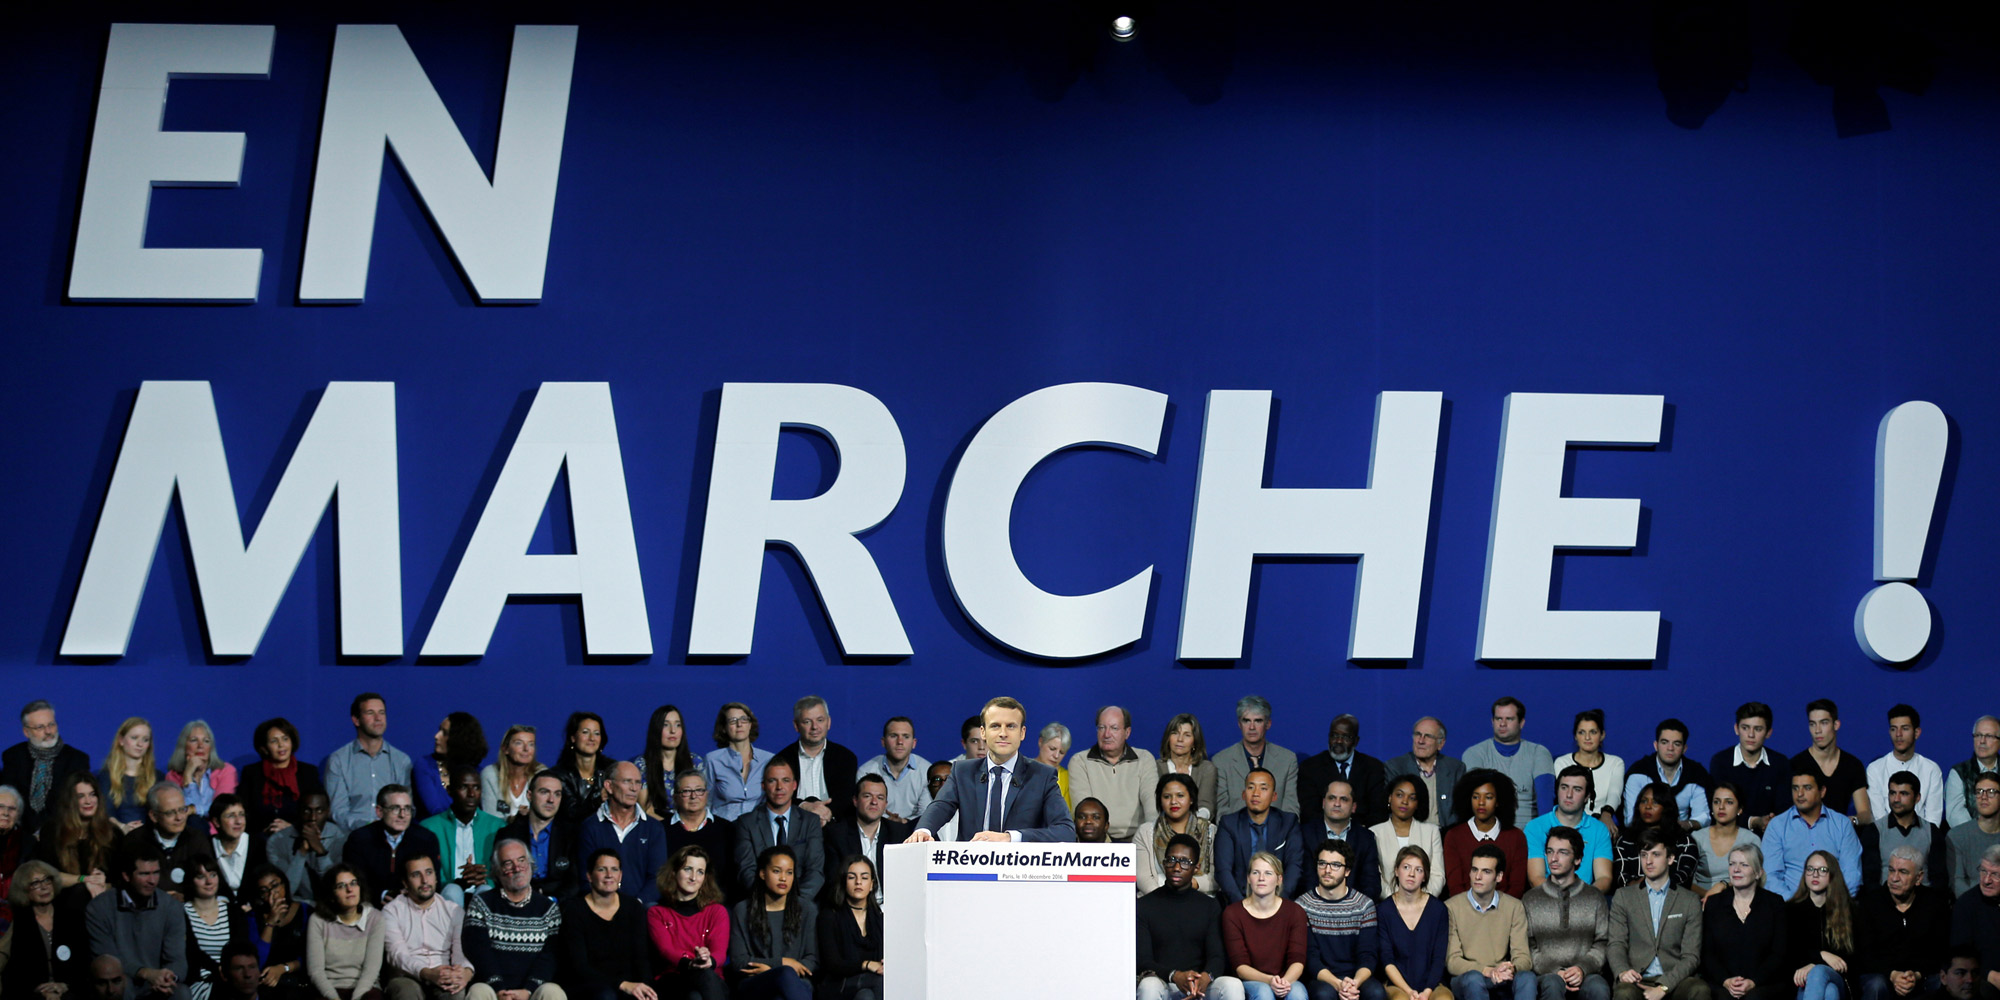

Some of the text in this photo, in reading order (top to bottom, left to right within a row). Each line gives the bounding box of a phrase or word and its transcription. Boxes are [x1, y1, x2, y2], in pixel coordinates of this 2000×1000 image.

[68, 22, 579, 304] EN
[59, 380, 1950, 664] MARCHE !
[931, 849, 1131, 868] #RévolutionEnMarche
